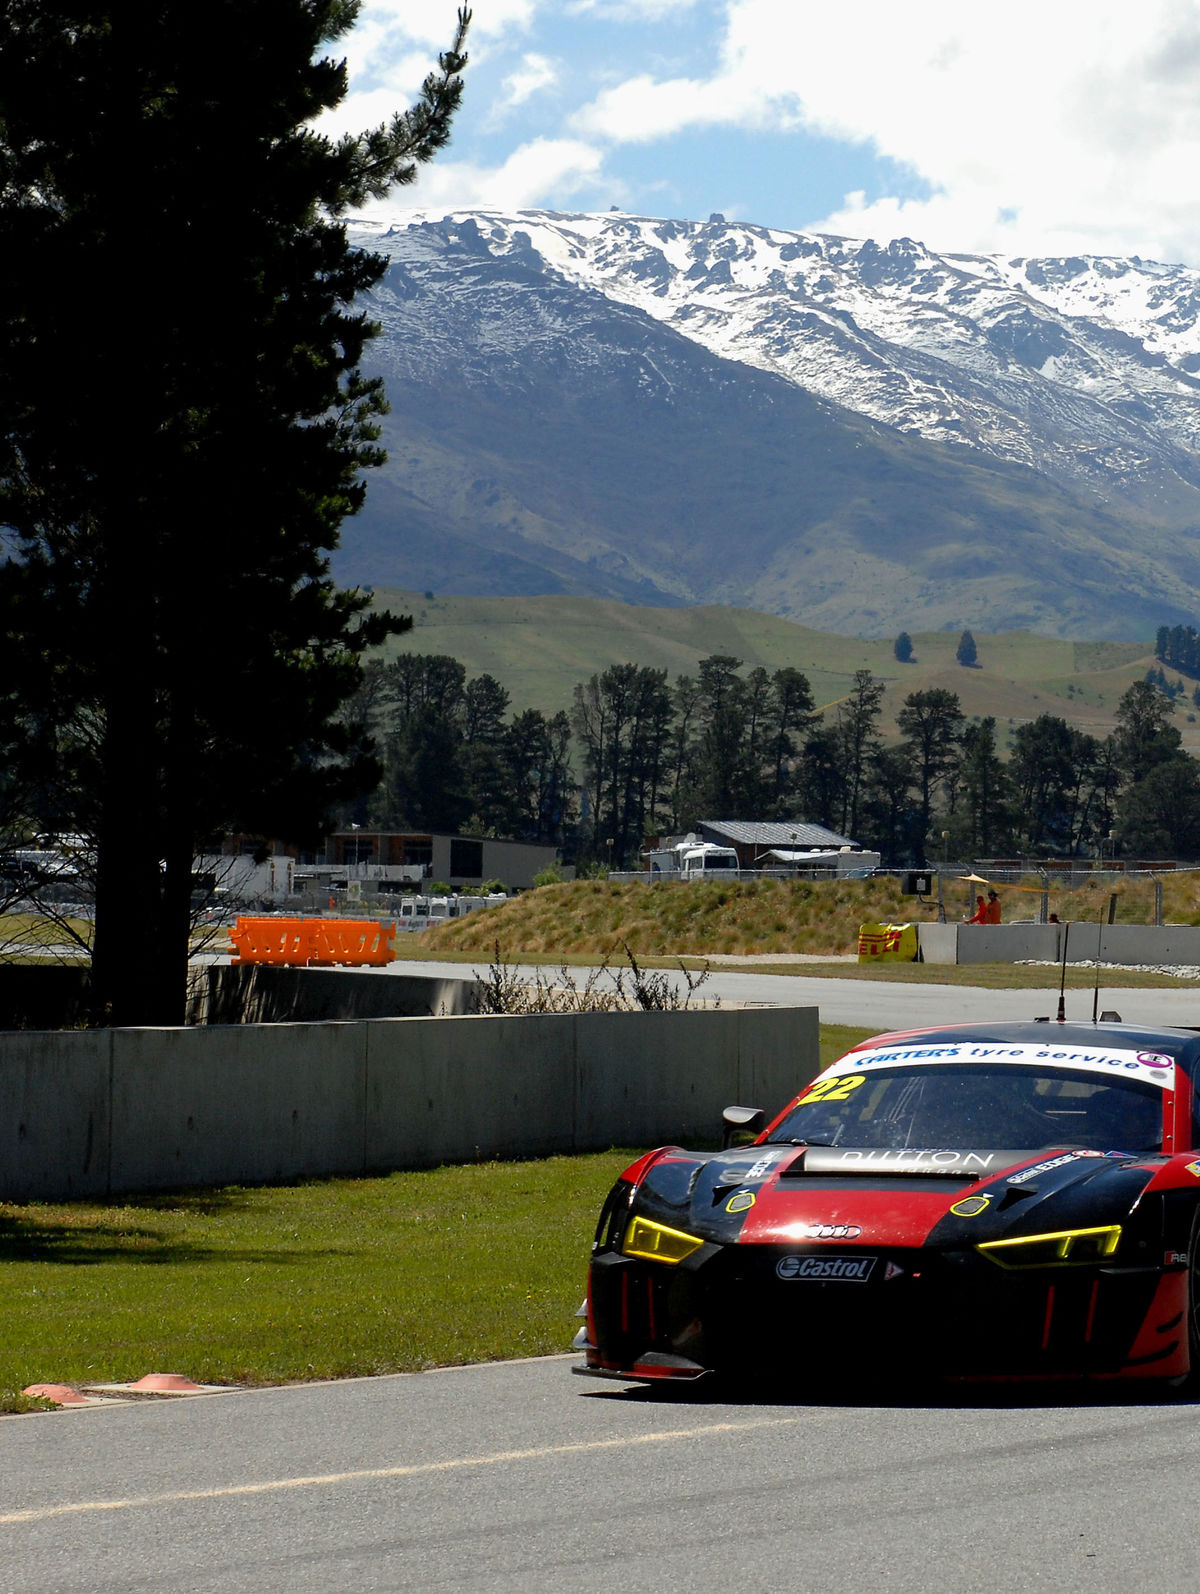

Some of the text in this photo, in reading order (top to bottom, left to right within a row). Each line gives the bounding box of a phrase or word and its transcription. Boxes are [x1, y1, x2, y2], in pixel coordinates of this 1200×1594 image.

[854, 1047, 1140, 1070] CARTER'S tyre service
[796, 1075, 868, 1106] 22
[1035, 1153, 1081, 1171] EDGE
[799, 1258, 868, 1277] Castrol
